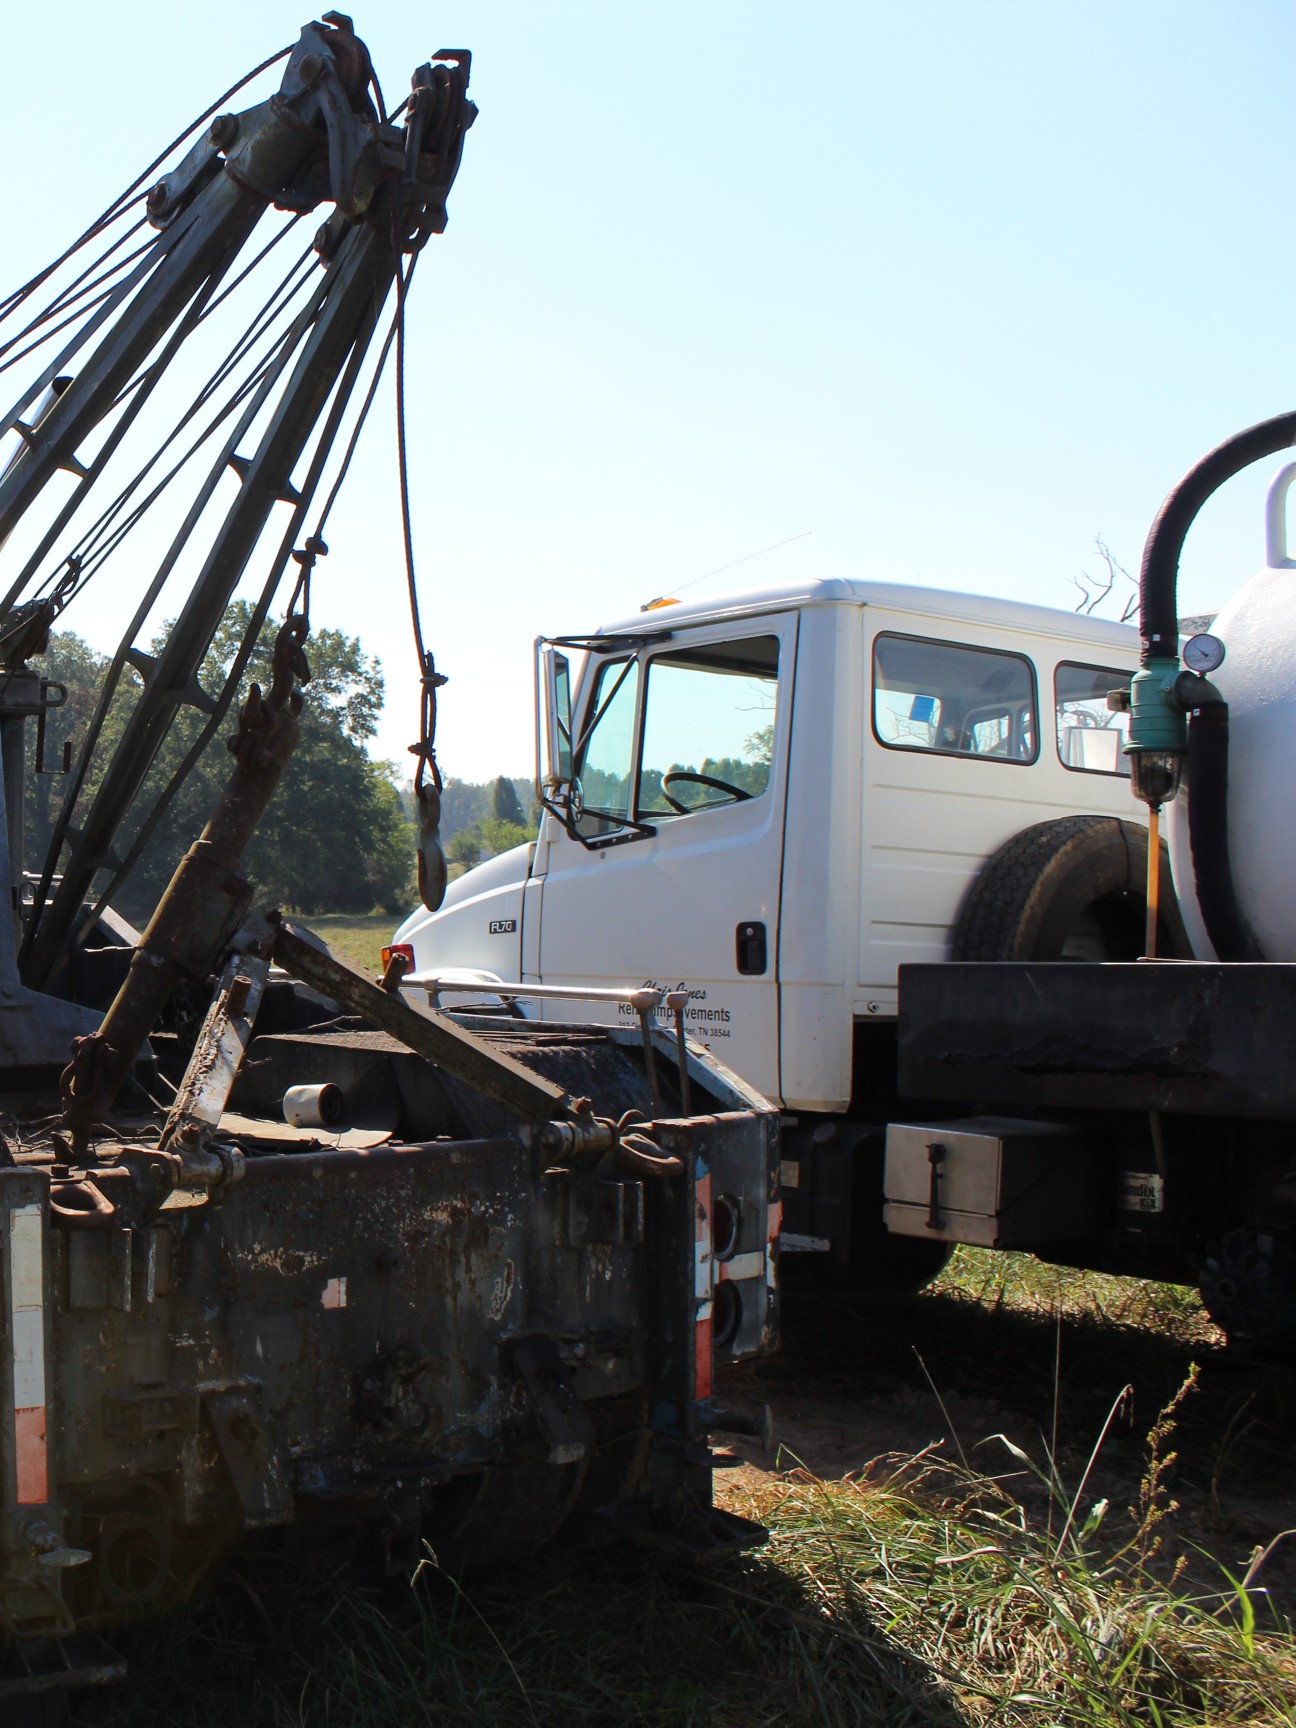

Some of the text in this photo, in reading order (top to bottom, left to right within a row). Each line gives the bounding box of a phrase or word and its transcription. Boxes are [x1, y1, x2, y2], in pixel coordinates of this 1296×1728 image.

[491, 921, 512, 933] FL70
[698, 1027, 708, 1036] TN
[709, 1028, 730, 1038] 38544
[1121, 1183, 1156, 1198] endix
